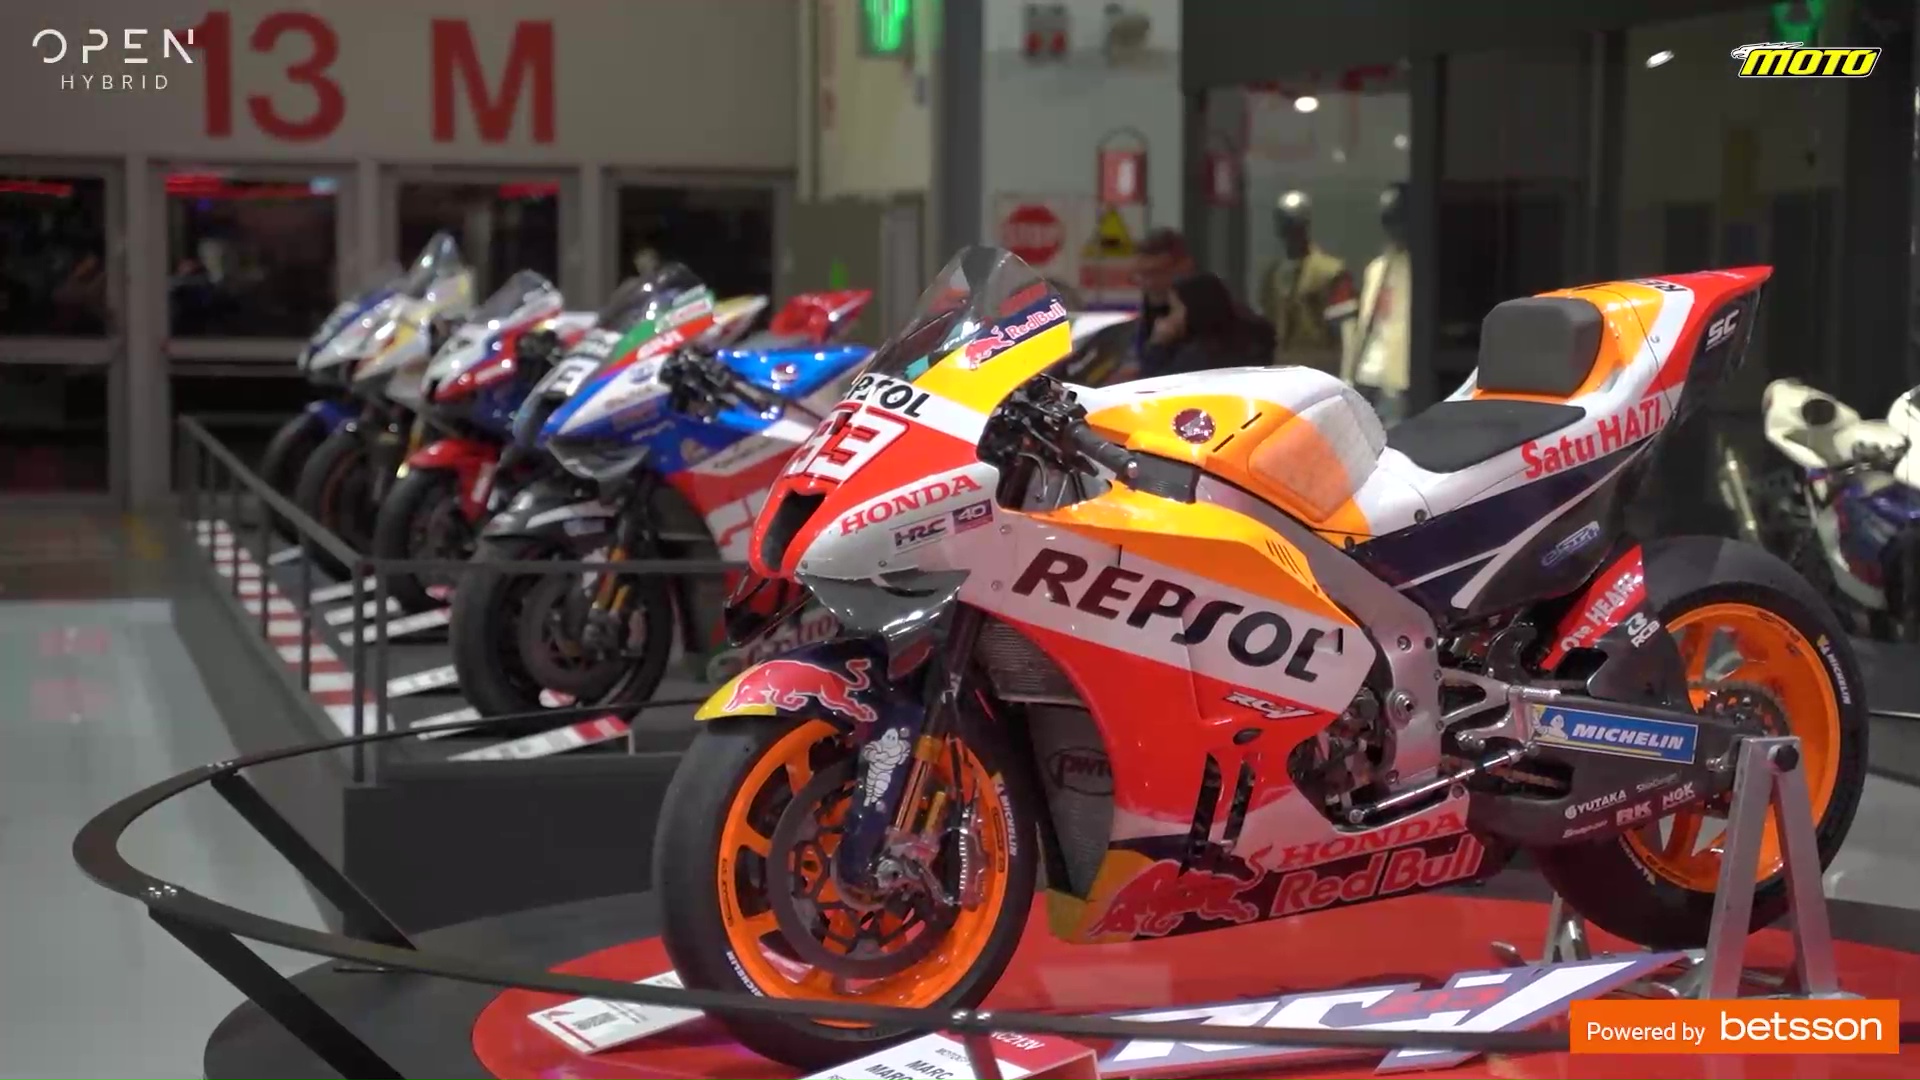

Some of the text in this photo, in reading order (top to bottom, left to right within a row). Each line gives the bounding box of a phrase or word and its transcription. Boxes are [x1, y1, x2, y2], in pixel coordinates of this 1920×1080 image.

[175, 11, 556, 144] 13 M
[1706, 309, 1740, 346] SC
[1521, 434, 1596, 479] Satu
[840, 475, 982, 536] HONDA
[894, 505, 986, 546] HRC 40
[1011, 548, 1326, 683] REPSOL
[1572, 723, 1684, 750] MICHELIN
[1000, 795, 1018, 856] MICHELIN
[1577, 789, 1627, 813] YUTAKA
[1277, 811, 1467, 869] HONDA
